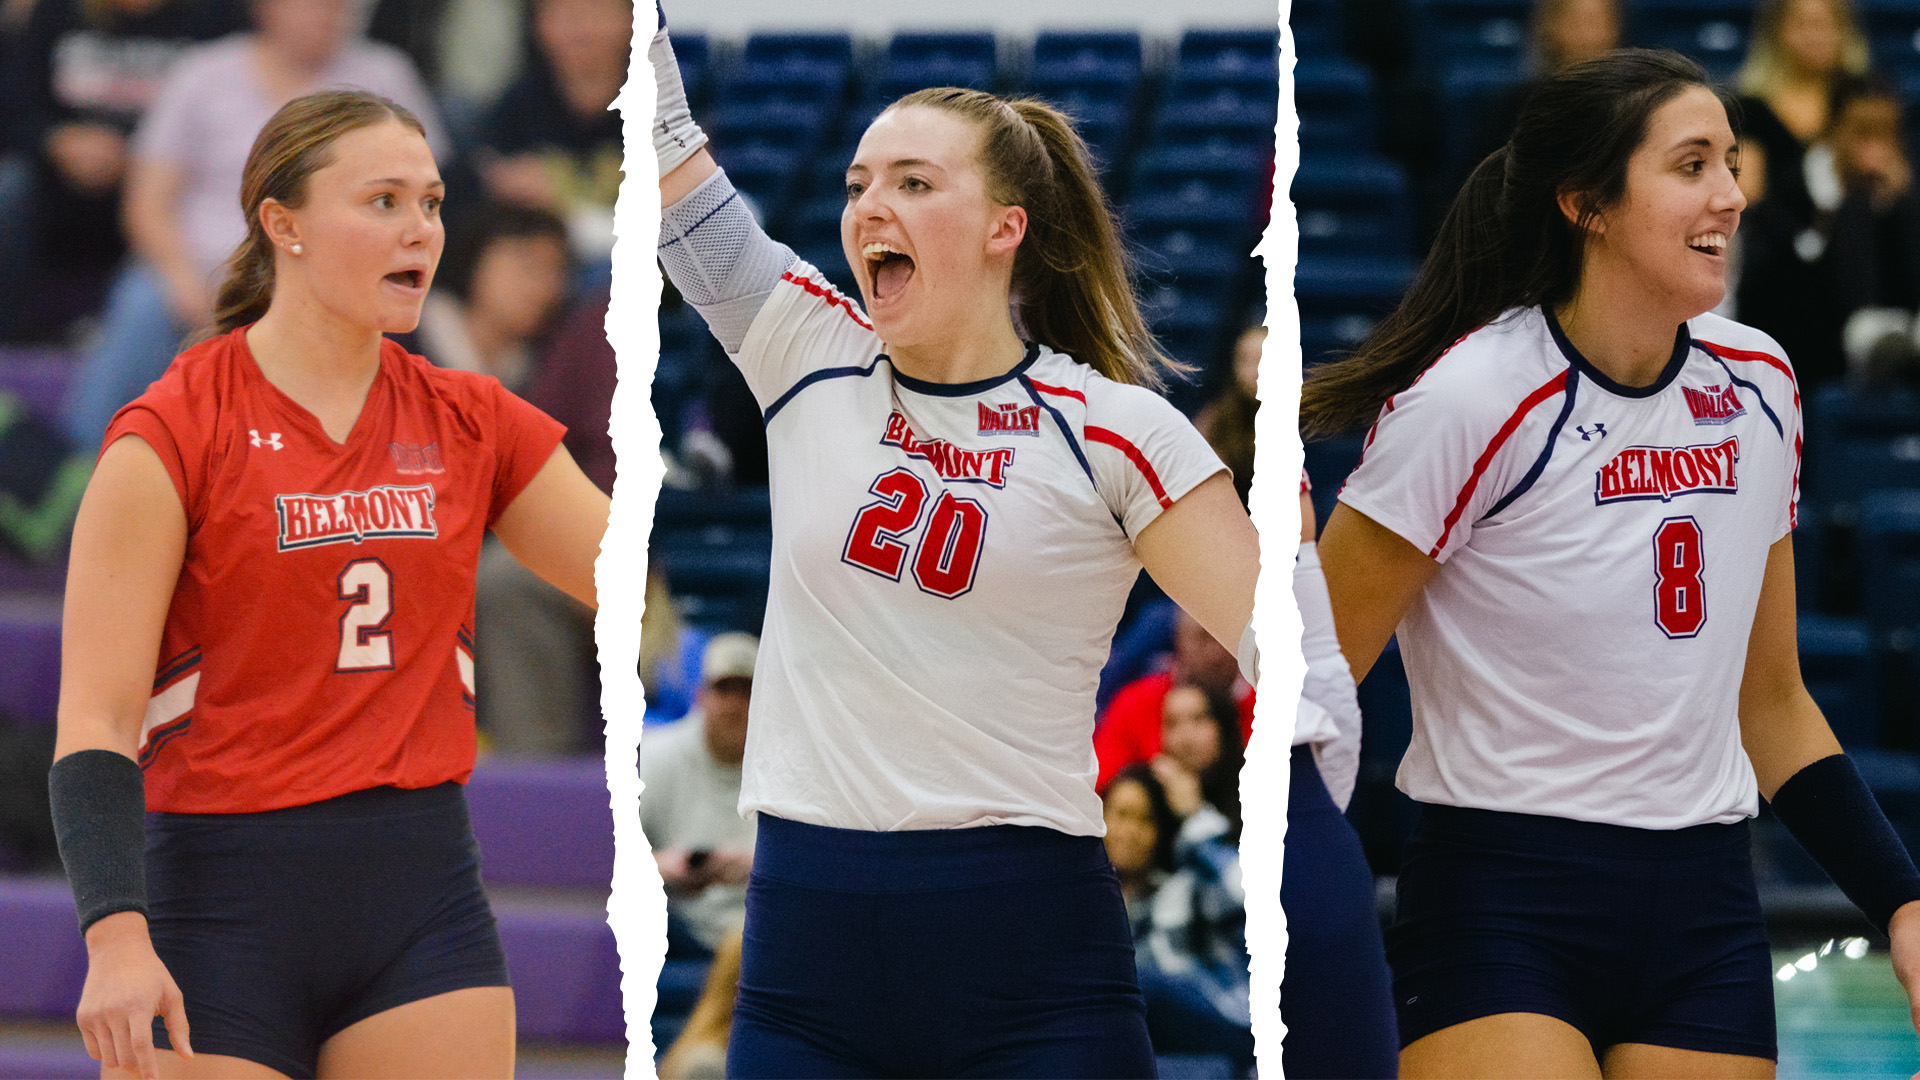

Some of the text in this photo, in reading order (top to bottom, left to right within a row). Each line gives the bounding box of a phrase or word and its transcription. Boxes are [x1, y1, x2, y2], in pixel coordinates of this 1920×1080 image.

[978, 401, 1041, 431] VALLEY
[998, 403, 1018, 411] THE
[1681, 382, 1744, 419] VALLEY
[1596, 437, 1739, 502] BELMONT
[279, 485, 436, 549] BELMONT
[841, 466, 988, 600] 20
[1653, 515, 1707, 639] 8
[334, 557, 395, 673] 2
